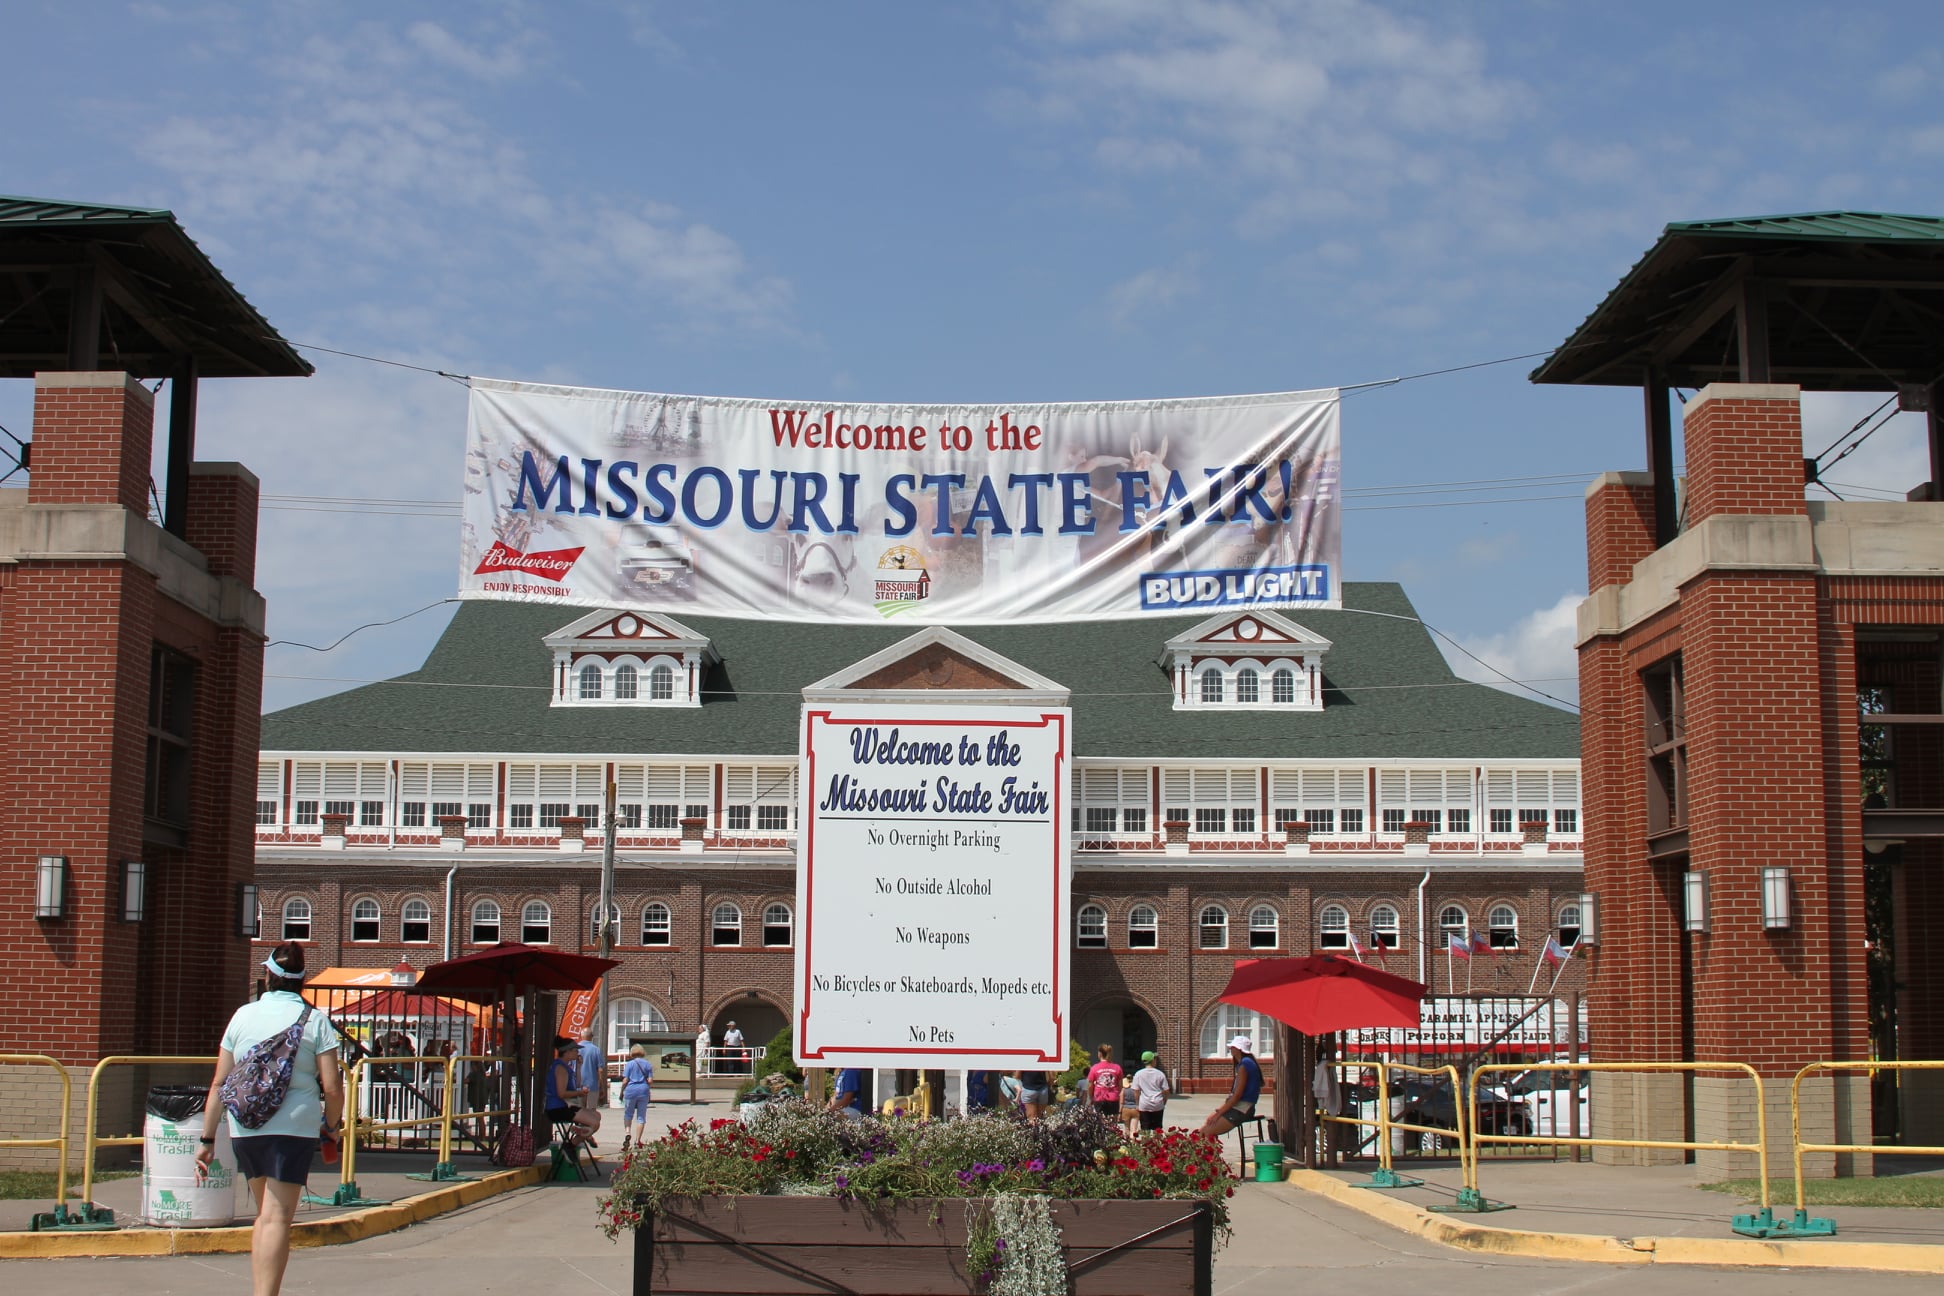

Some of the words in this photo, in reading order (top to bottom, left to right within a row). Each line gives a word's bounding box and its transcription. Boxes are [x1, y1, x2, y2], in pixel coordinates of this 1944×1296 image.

[769, 409, 926, 451] Welcome
[939, 419, 973, 452] to
[985, 412, 1042, 451] the
[512, 450, 860, 536] MISSOURI
[883, 472, 1096, 537] STATE
[1115, 459, 1293, 535] FAIR!
[483, 547, 575, 571] Budweiser
[483, 582, 511, 592] ENJOY
[512, 583, 571, 597] RESPONSIBLY
[875, 582, 917, 592] MISSOURI
[875, 592, 899, 600] STATE
[899, 592, 917, 601] FAIR
[1145, 575, 1221, 605] BUD
[1225, 570, 1322, 600] LIGHT
[850, 727, 953, 765] Welcome
[959, 734, 981, 767] to
[986, 729, 1022, 767] the
[820, 773, 927, 813] Missouri
[932, 775, 993, 814] State
[998, 776, 1050, 815] Fair
[867, 828, 884, 846] No
[889, 829, 949, 852] Overnight
[953, 830, 1001, 852] Parking
[875, 877, 892, 894] No
[897, 877, 943, 895] Outside
[946, 878, 992, 896] Alcohol
[895, 927, 912, 944] No
[917, 927, 970, 950] Weapons
[813, 974, 830, 992] No
[834, 974, 881, 998] Bicycles
[883, 981, 897, 993] or
[900, 976, 978, 997] Skateboards,
[981, 977, 1028, 1000] Mopeds
[1031, 979, 1052, 995] etc.
[909, 1025, 926, 1042] No
[930, 1026, 955, 1043] Pets
